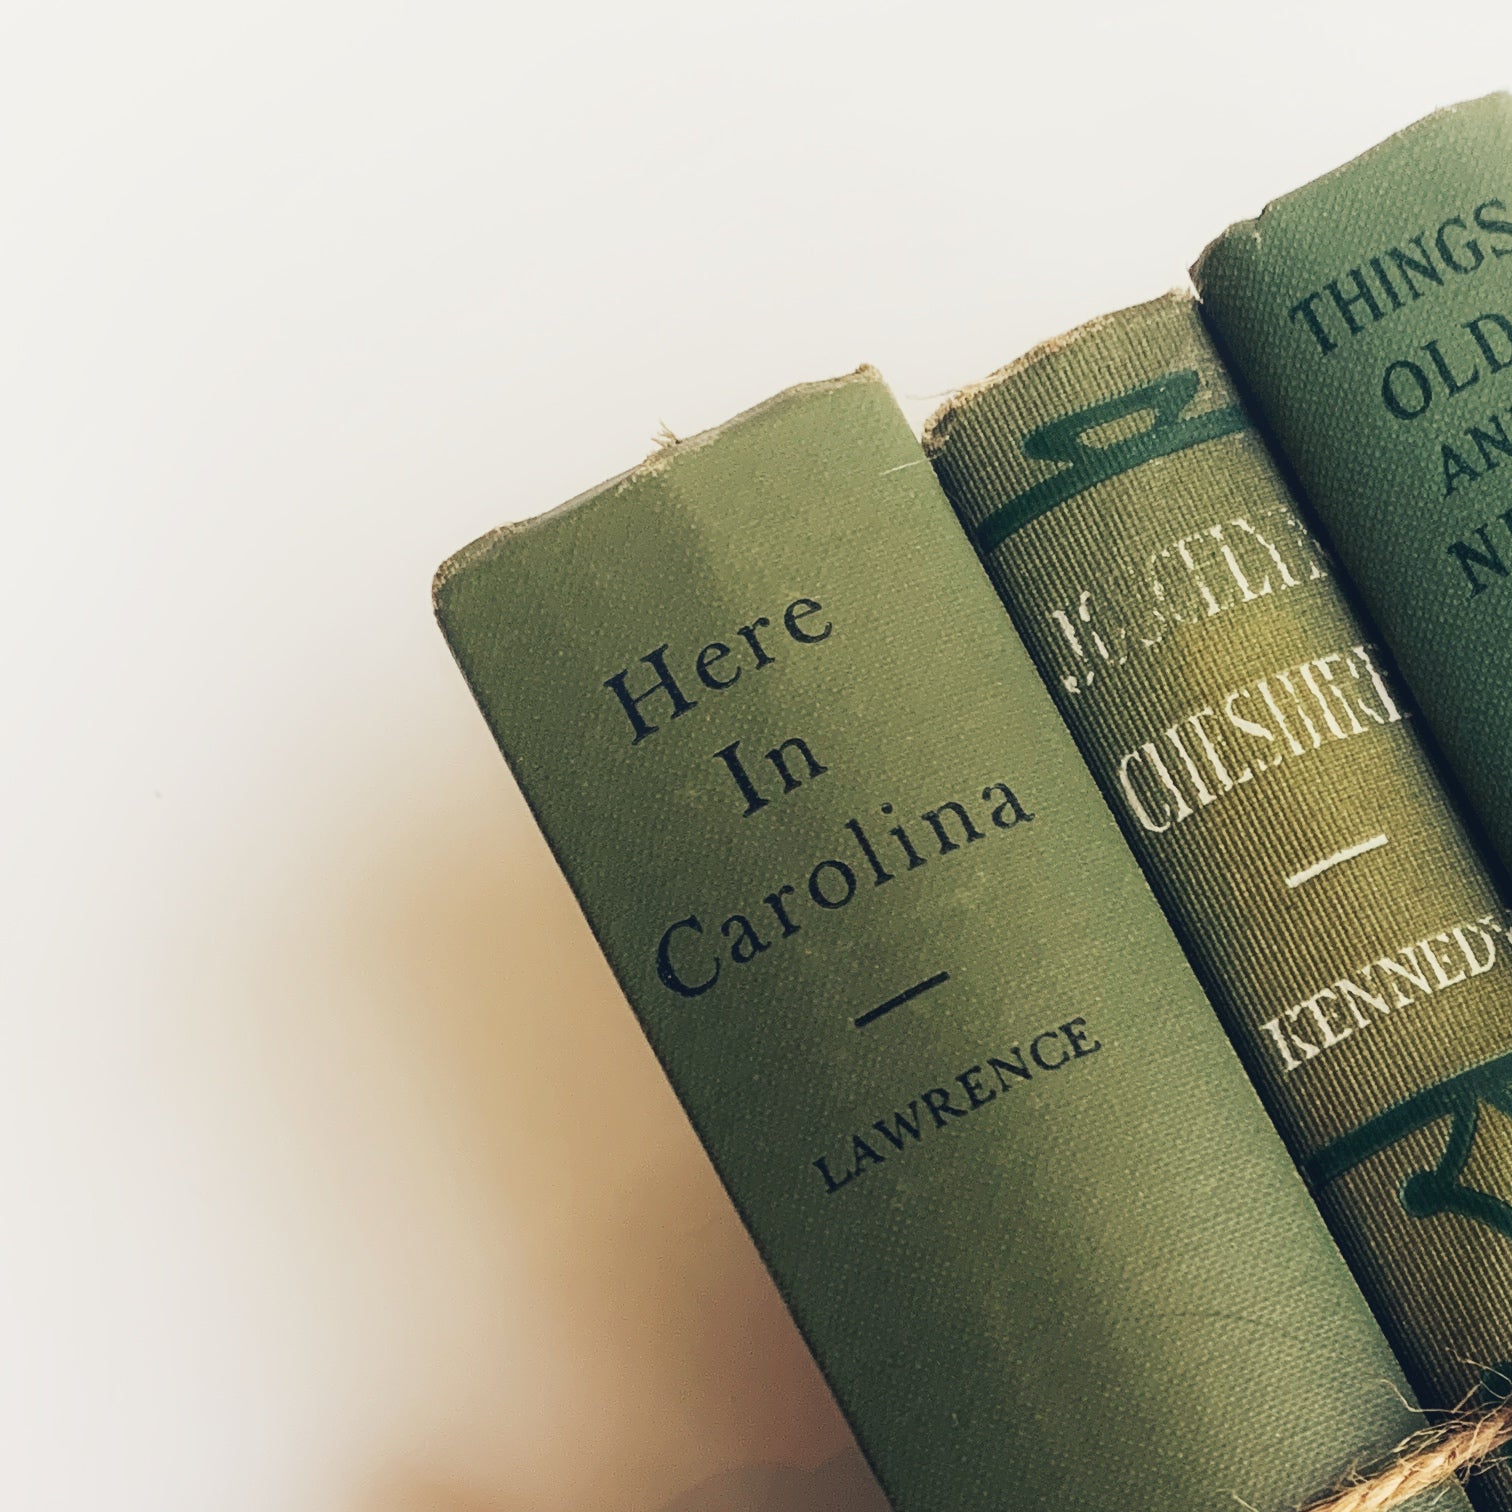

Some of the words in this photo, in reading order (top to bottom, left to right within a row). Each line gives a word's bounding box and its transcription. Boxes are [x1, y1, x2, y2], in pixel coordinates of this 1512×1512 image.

[603, 598, 832, 745] Here
[713, 737, 828, 818] In
[654, 782, 1036, 998] Carolina
[812, 1017, 1101, 1194] LAWRENCE
